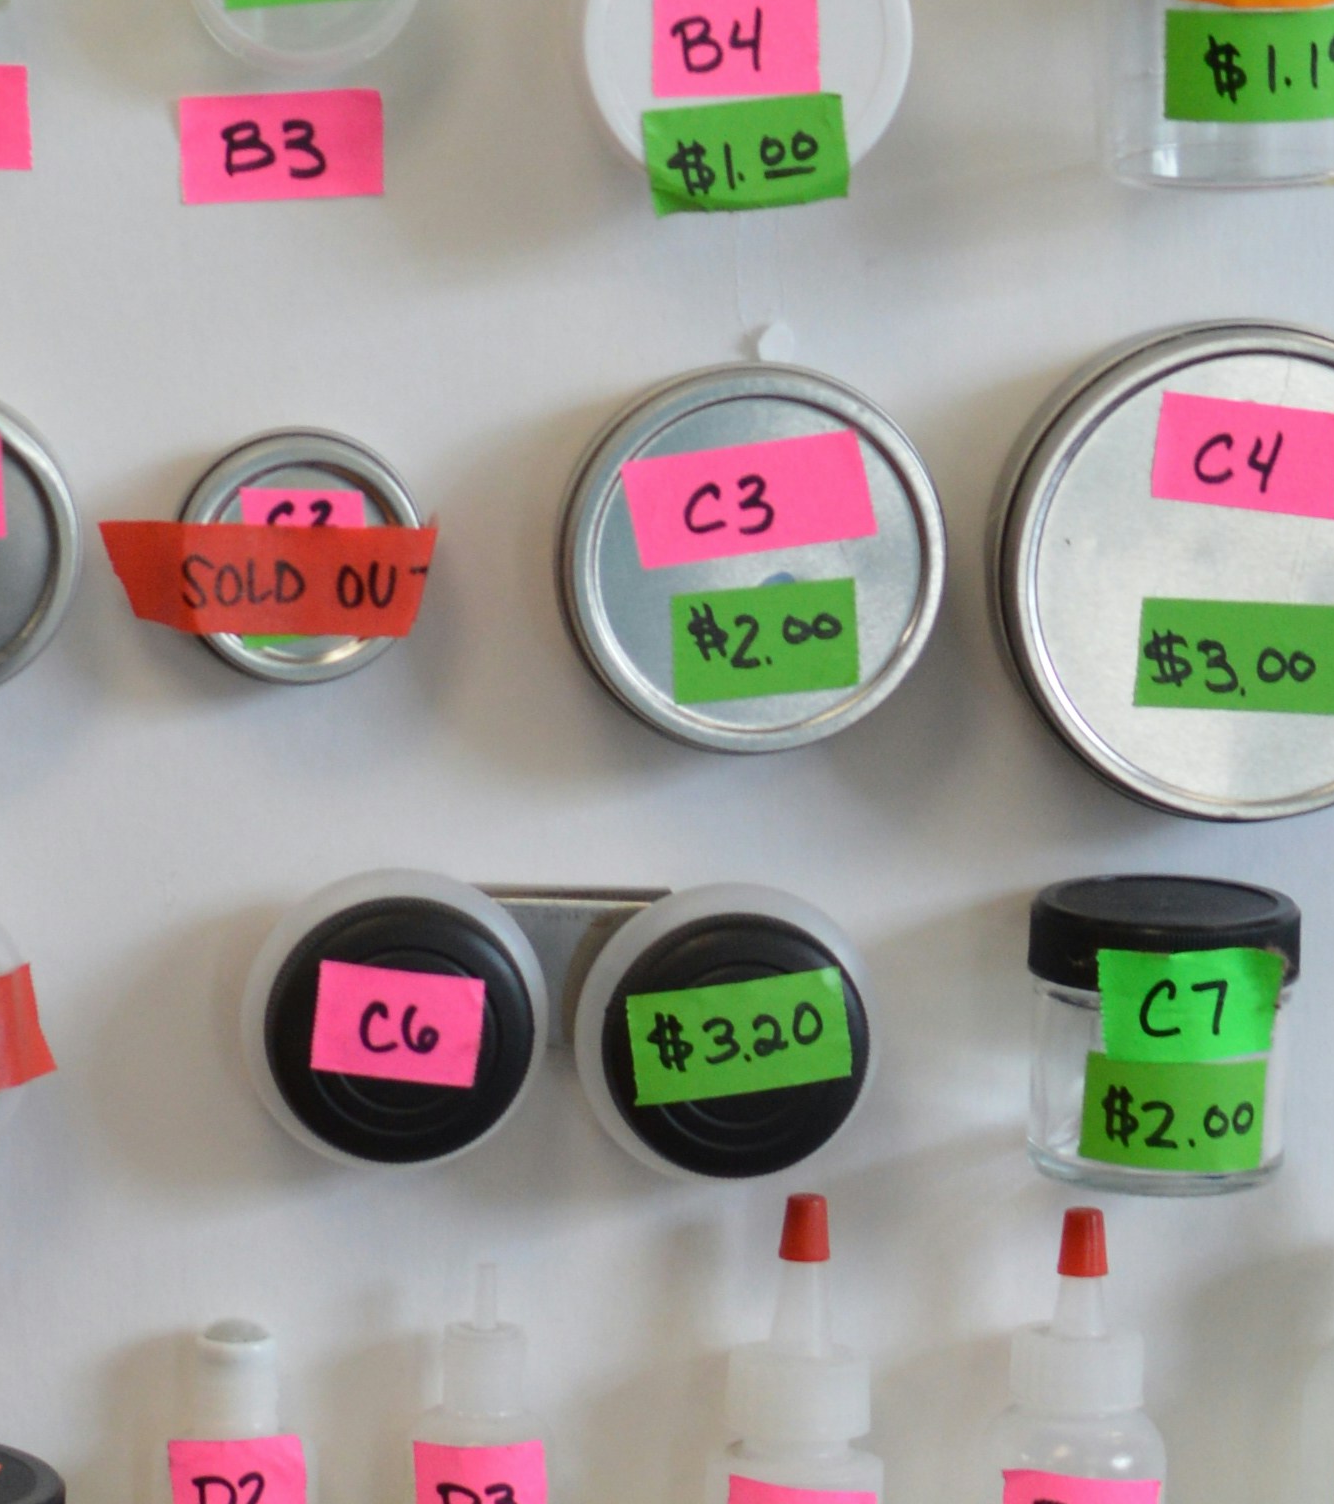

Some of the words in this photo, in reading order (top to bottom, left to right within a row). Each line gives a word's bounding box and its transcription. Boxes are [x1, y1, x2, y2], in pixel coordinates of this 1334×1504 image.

[671, 6, 764, 75] B4
[220, 119, 328, 180] B3
[667, 129, 820, 196] $1.00
[1191, 430, 1284, 494] C4
[683, 473, 776, 537] C3
[181, 553, 306, 609] SOLD
[686, 602, 843, 671] $2.00
[1143, 629, 1317, 697] $3.00
[357, 1001, 441, 1055] C6
[646, 1002, 825, 1074] $3.20
[1138, 979, 1229, 1038] C7
[1101, 1084, 1256, 1150] $2.00
